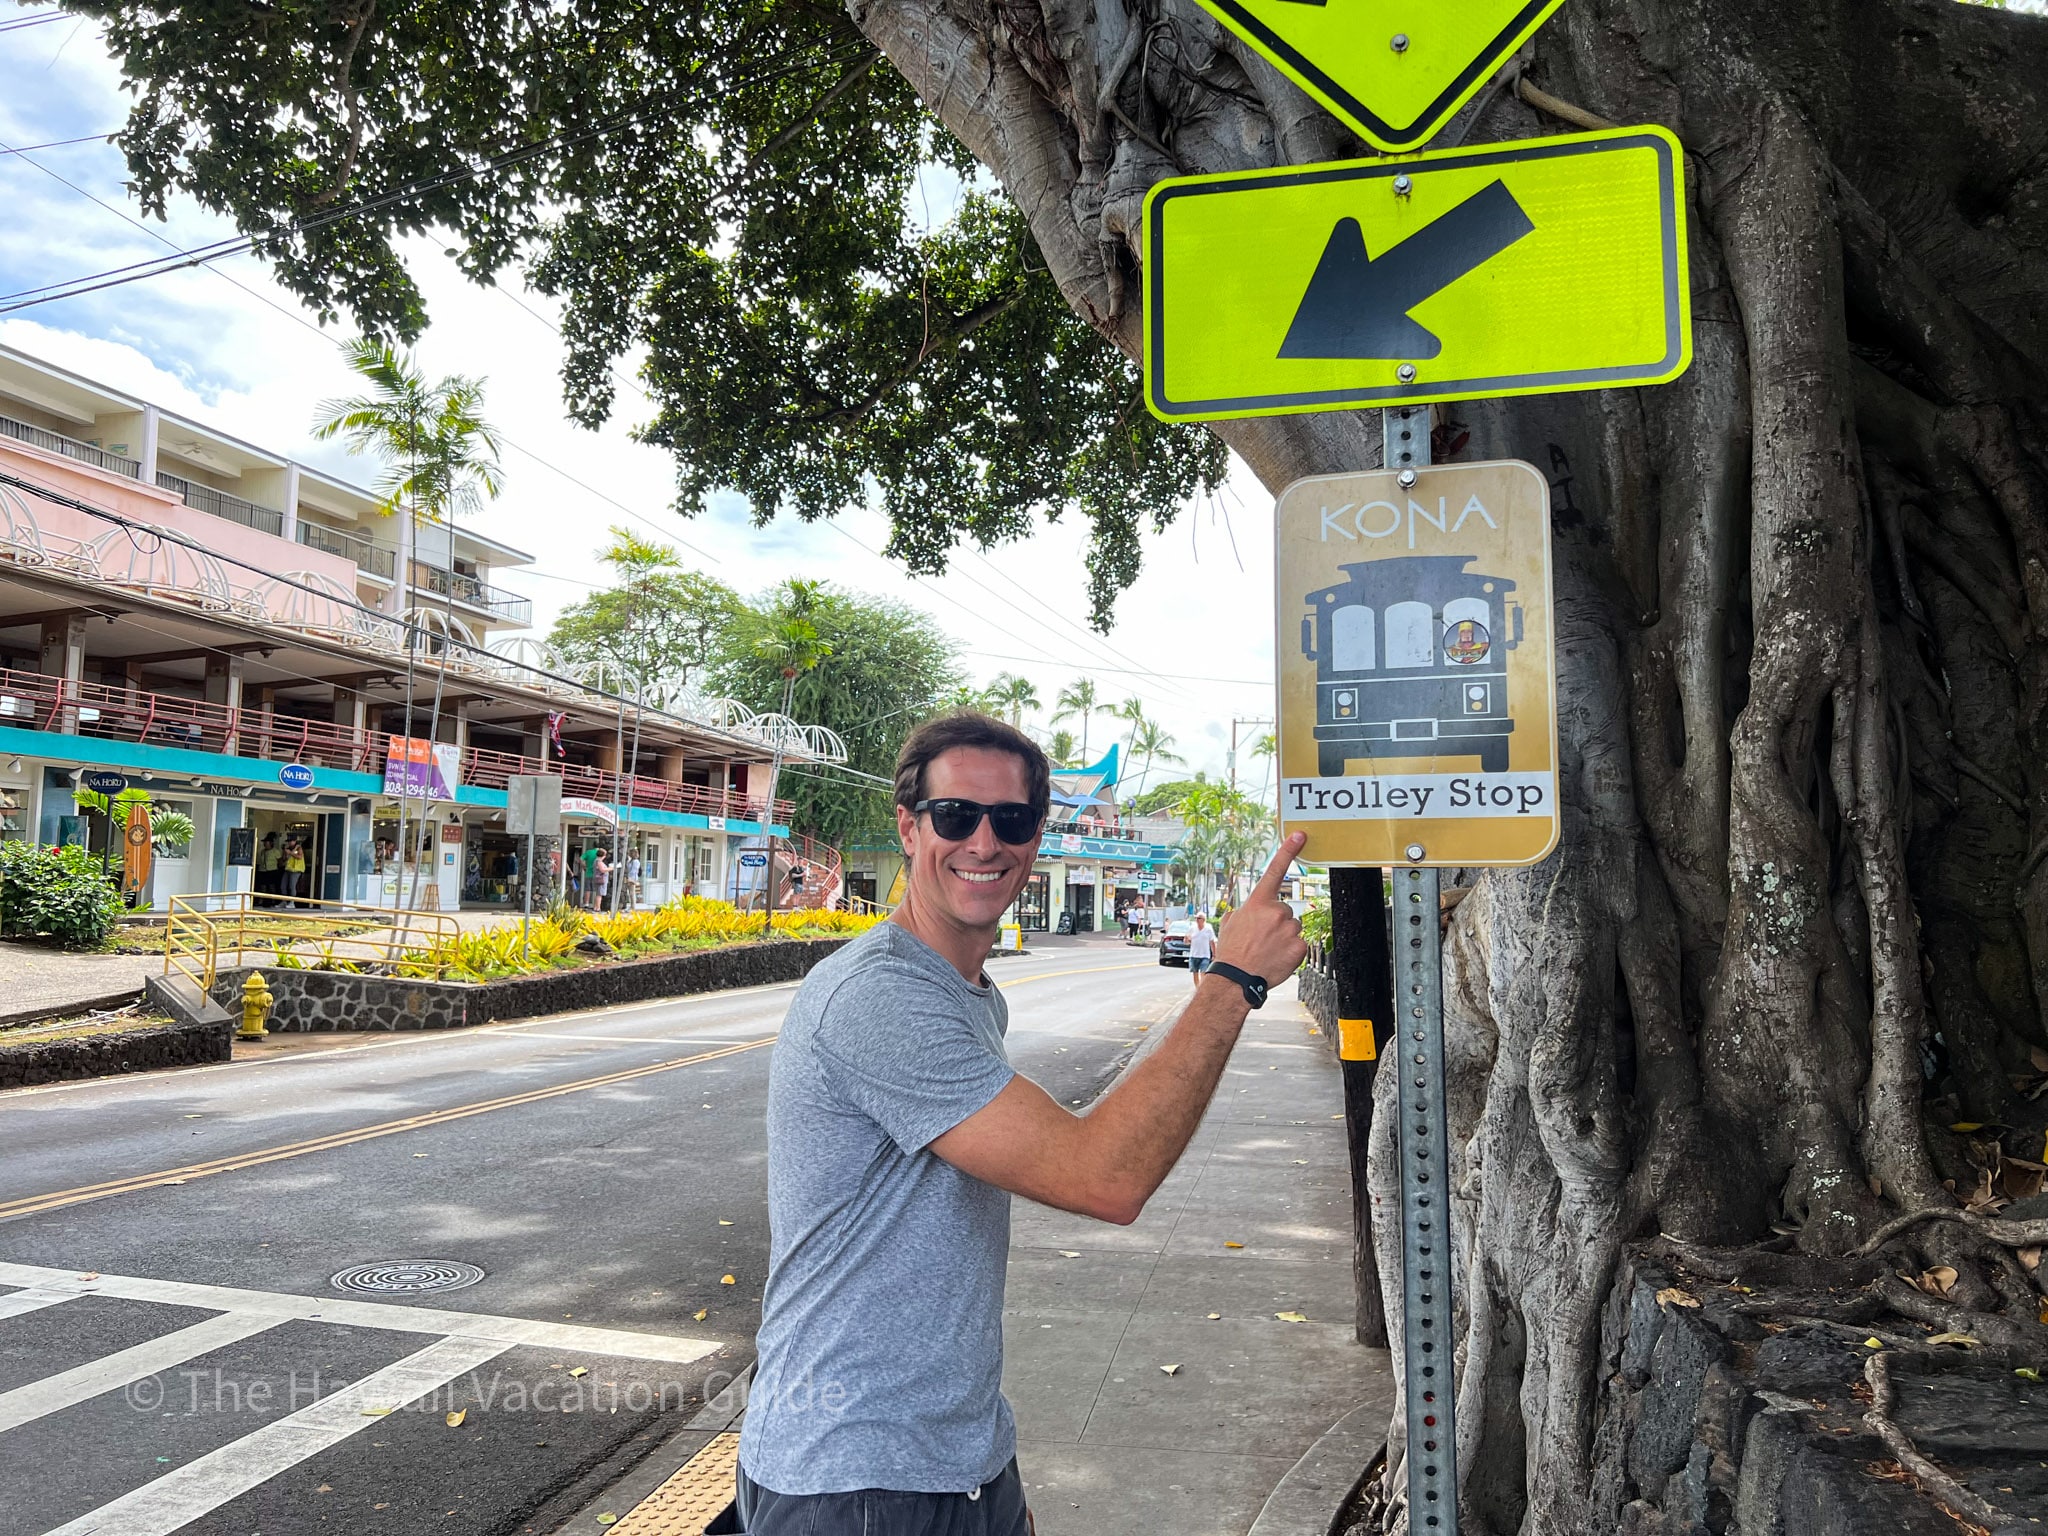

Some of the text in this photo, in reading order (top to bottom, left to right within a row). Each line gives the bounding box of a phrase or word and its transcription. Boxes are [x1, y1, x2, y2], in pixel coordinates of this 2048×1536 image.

[1320, 494, 1498, 549] KONA
[88, 778, 123, 787] NA HOKU
[283, 770, 313, 781] NA HOKU
[210, 784, 224, 795] NA
[384, 781, 438, 798] 808-29-646
[1288, 777, 1544, 815] Trolley Stop
[575, 799, 614, 822] Marketplace
